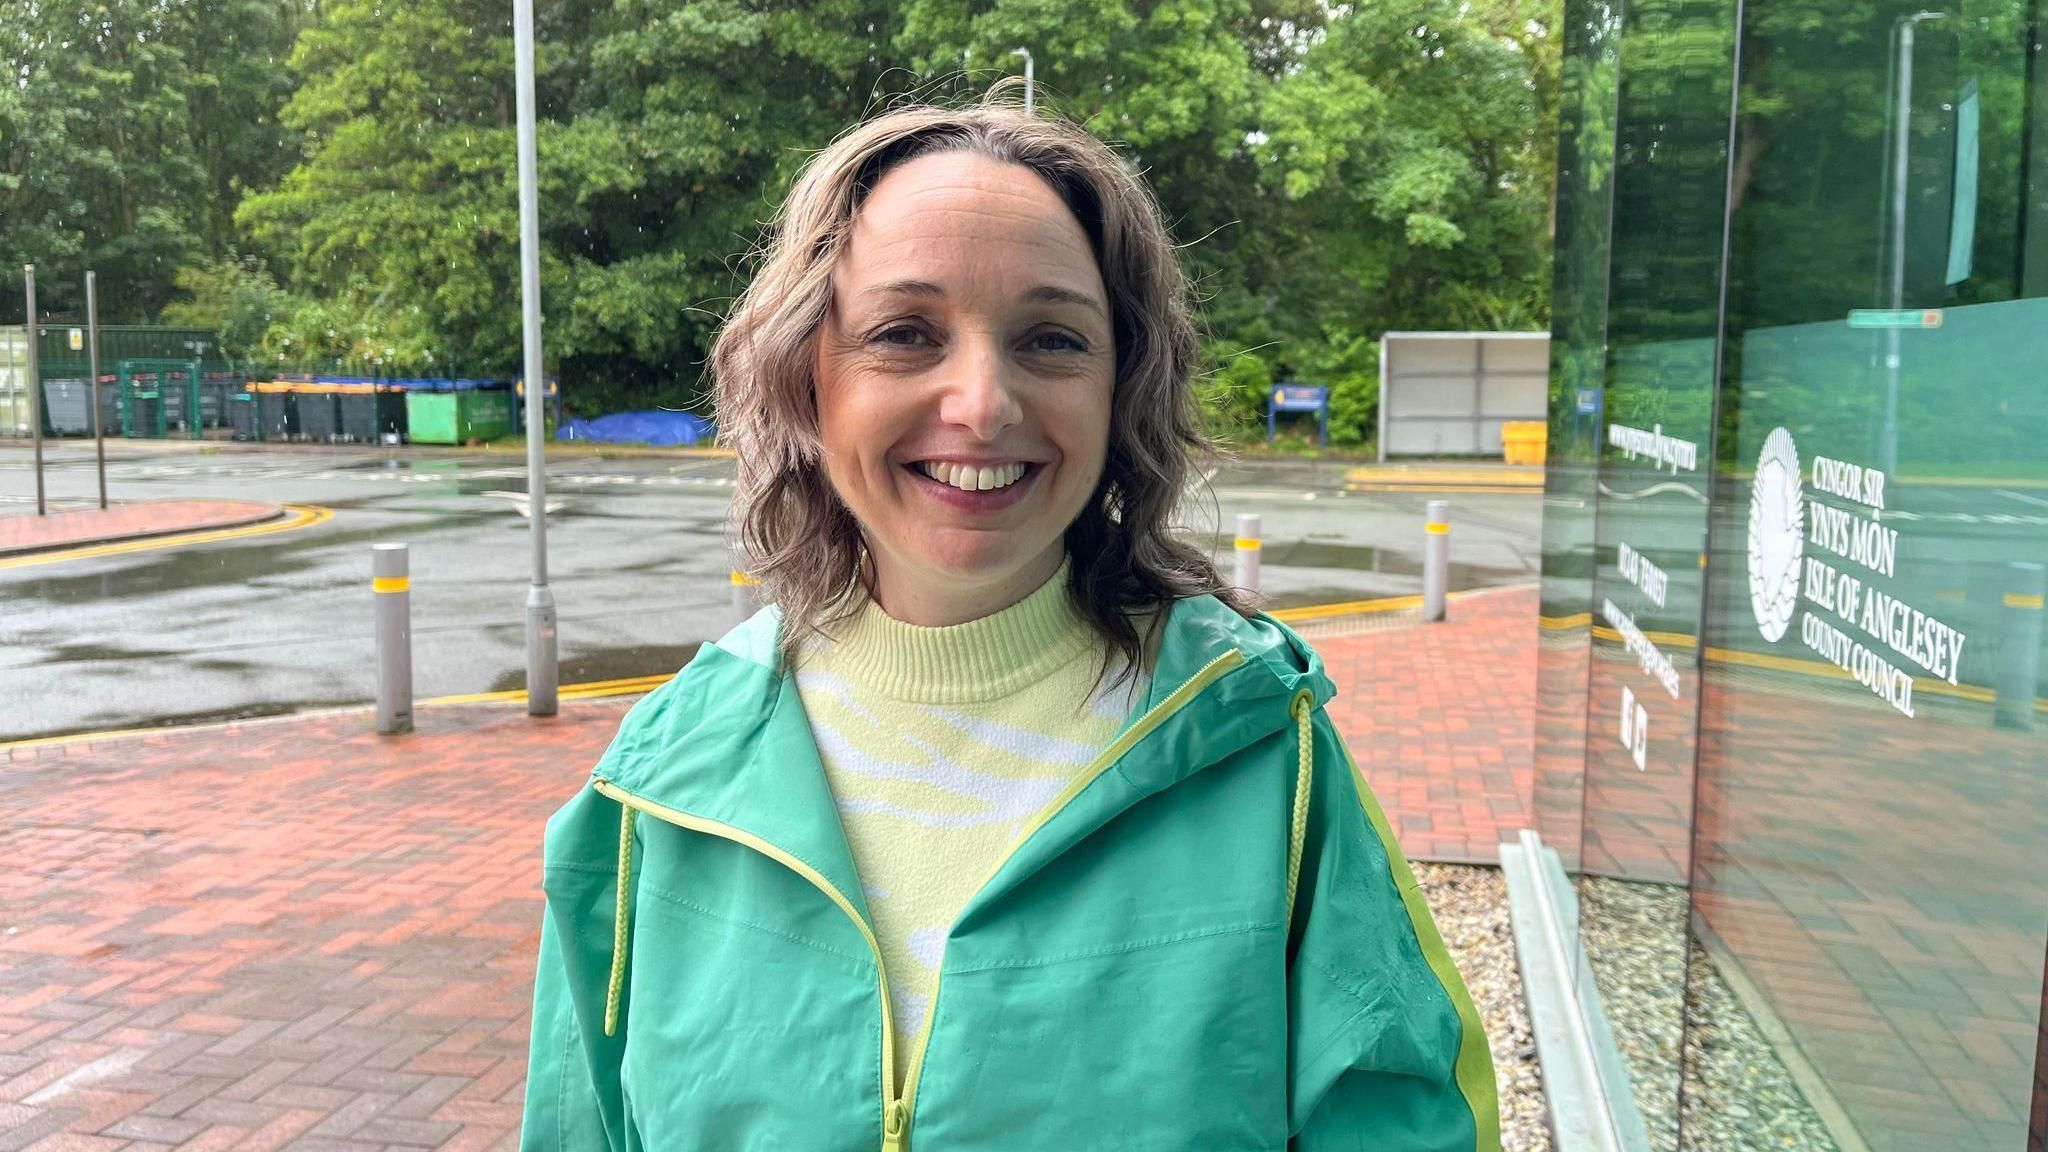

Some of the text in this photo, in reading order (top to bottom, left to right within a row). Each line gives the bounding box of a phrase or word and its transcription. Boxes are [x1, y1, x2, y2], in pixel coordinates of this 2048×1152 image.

[1812, 456, 1884, 510] CYNGOR SIR
[1810, 502, 1850, 557] YNYS
[1804, 557, 1966, 686] ISLE OF ANGLESEY
[1802, 612, 1914, 718] COUNTY COUNCIL
